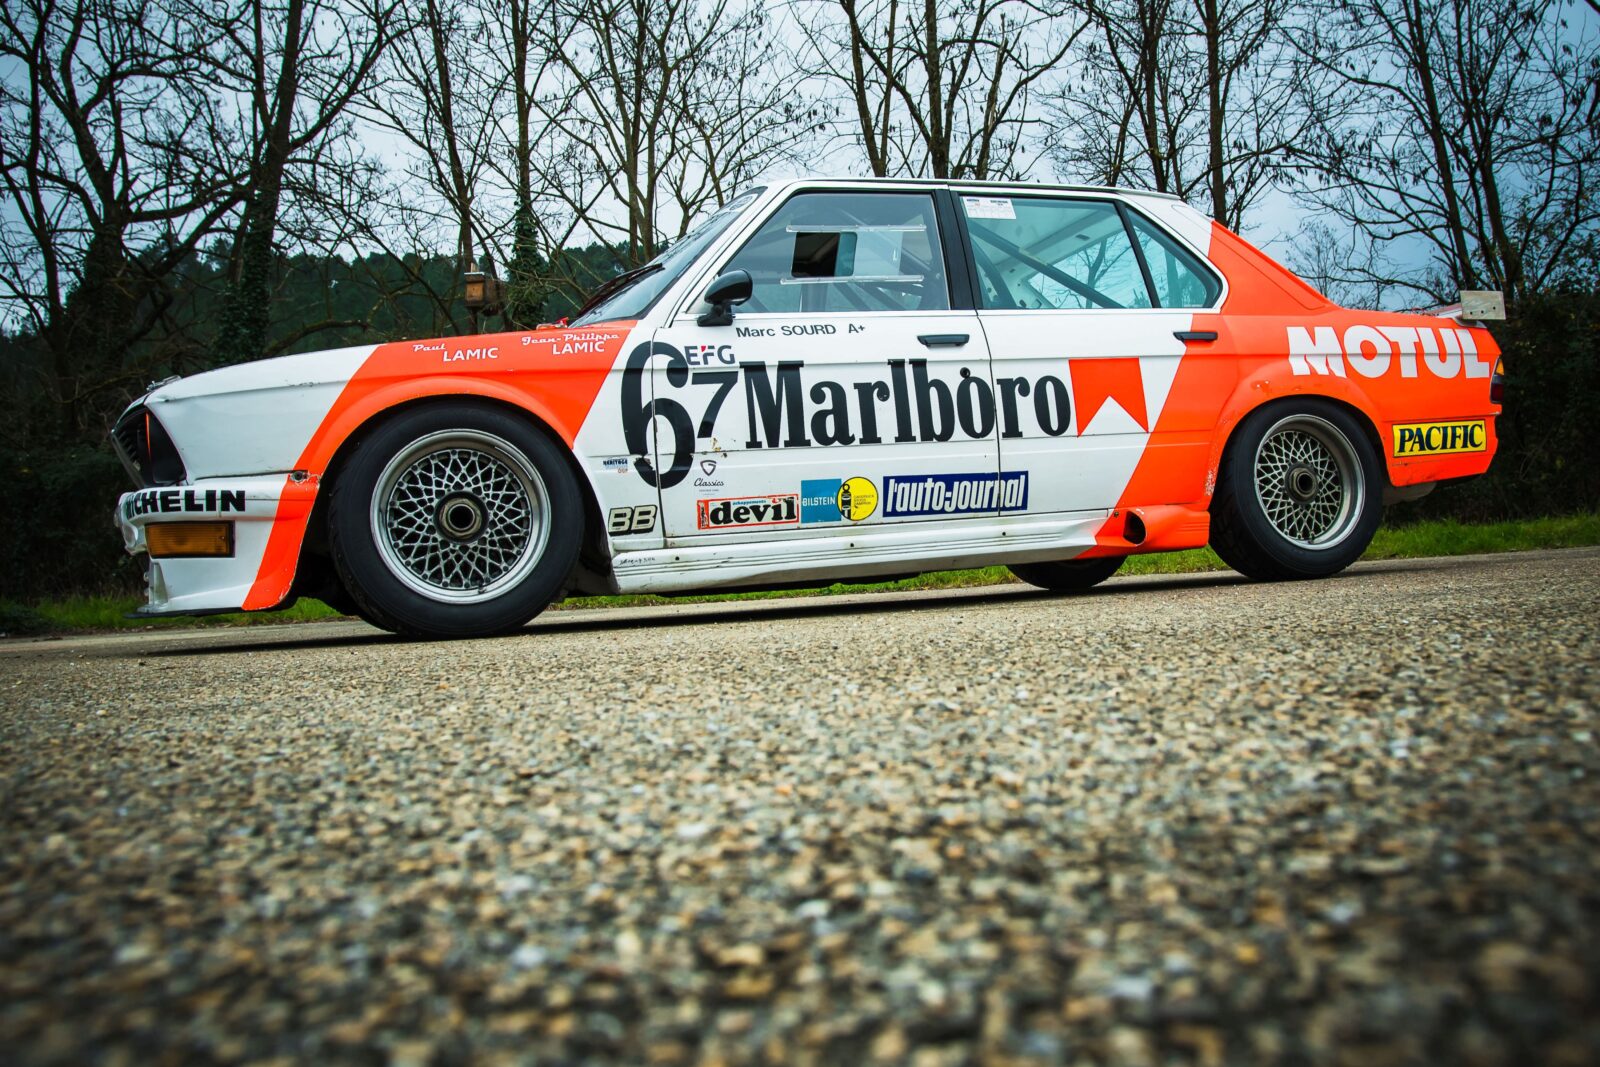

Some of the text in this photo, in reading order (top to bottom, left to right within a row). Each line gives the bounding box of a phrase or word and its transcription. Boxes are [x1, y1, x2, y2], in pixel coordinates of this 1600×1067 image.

[735, 323, 866, 338] Marc SOURD A+
[521, 332, 620, 346] Jean-Philippe
[412, 343, 446, 352] Paul
[443, 347, 499, 362] LAMIC
[552, 341, 605, 355] LAMIC
[1286, 325, 1490, 379] MOTUL
[684, 345, 736, 366] EFG
[739, 358, 1071, 449] Marlboro
[1397, 424, 1483, 453] PACIFIC
[693, 477, 724, 487] Classics
[802, 496, 836, 507] BILSTEIN
[886, 475, 1025, 513] l'auto-journal
[709, 497, 797, 525] devil
